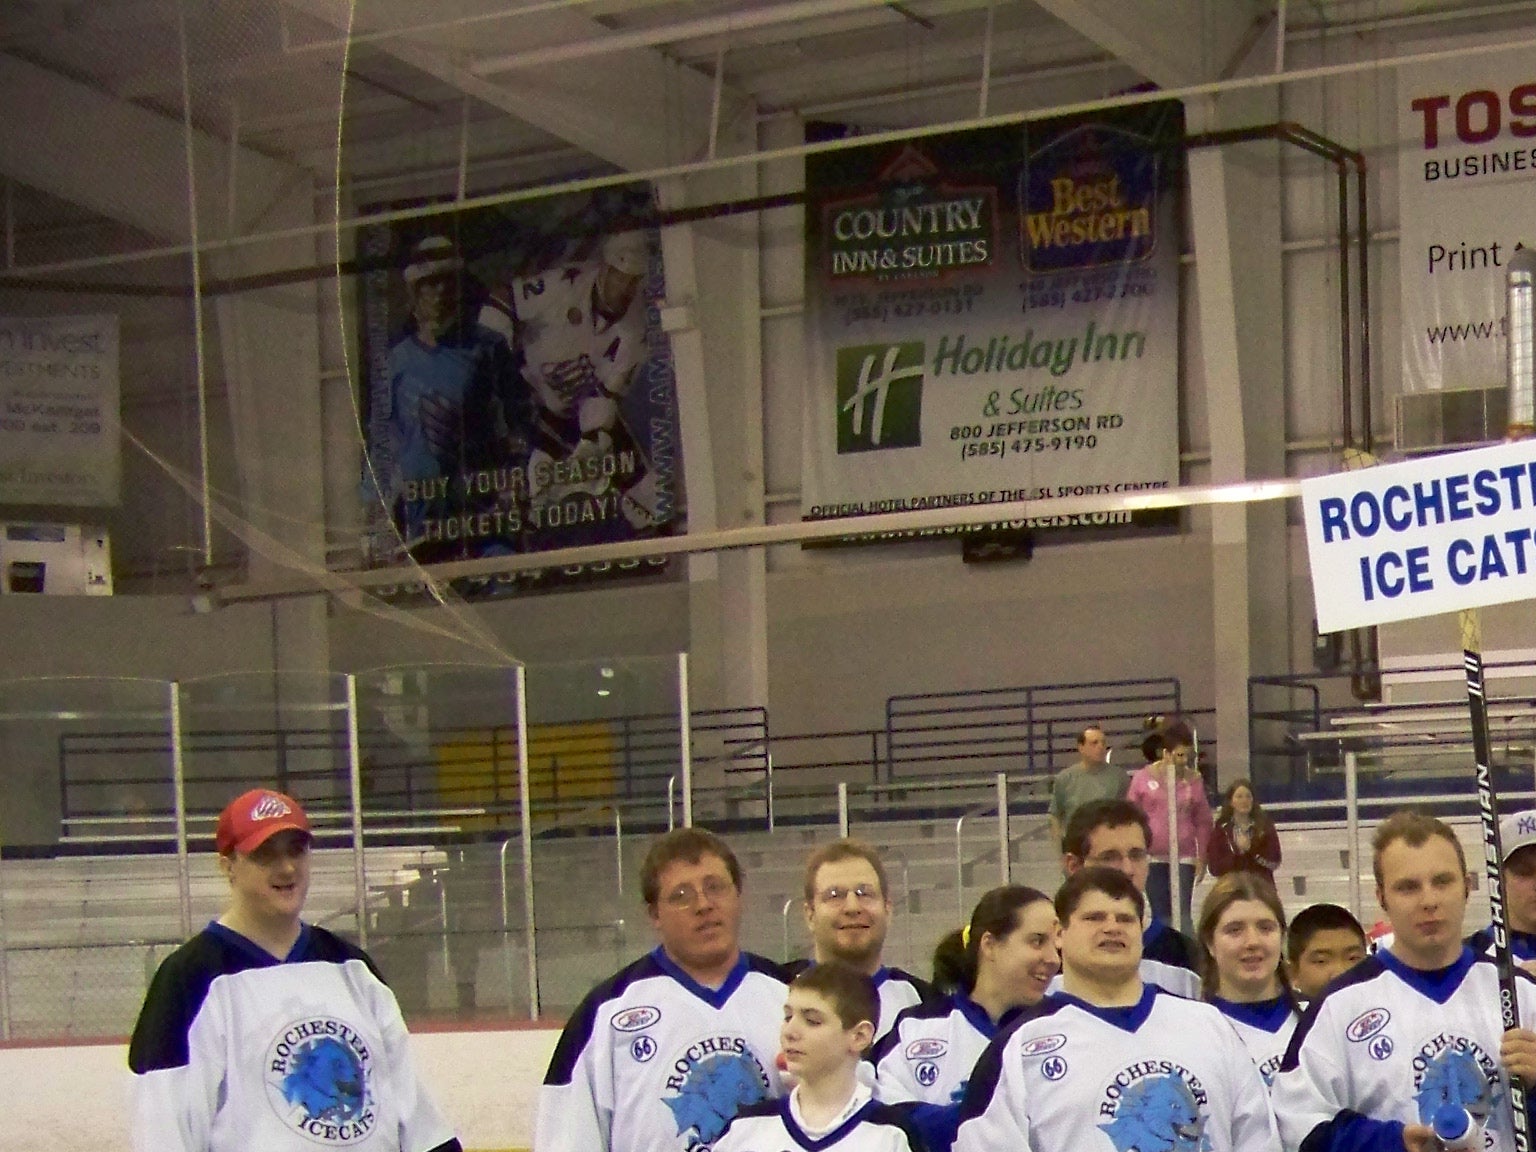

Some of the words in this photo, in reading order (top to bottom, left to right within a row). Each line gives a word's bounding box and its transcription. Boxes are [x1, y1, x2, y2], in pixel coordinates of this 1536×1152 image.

[1051, 174, 1121, 214] Best
[834, 199, 985, 241] COUNTRY
[1026, 207, 1151, 250] Western
[902, 240, 988, 269] SUITES
[1428, 243, 1502, 274] Print
[932, 329, 1077, 377] Holiday
[1083, 321, 1147, 363] Inn
[1007, 385, 1084, 415] Suites
[950, 424, 982, 441] 800
[986, 416, 1091, 438] JEFFERSON
[1096, 413, 1124, 430] RD
[960, 440, 1006, 460] (585)
[406, 476, 449, 501] BUY
[463, 466, 525, 496] YOUR
[535, 450, 635, 487] SEASON
[911, 491, 975, 510] PARTNERS
[978, 490, 996, 503] OF
[1001, 488, 1027, 502] THE
[1058, 483, 1111, 499] SPORTS
[422, 509, 522, 541] TICKETS
[1360, 546, 1434, 601] ICE
[1477, 763, 1508, 950] CHRISTIAN
[271, 1019, 371, 1076] ROCHESTER
[1099, 1060, 1208, 1119] ROCHESTER
[298, 1109, 375, 1142] ICECATS
